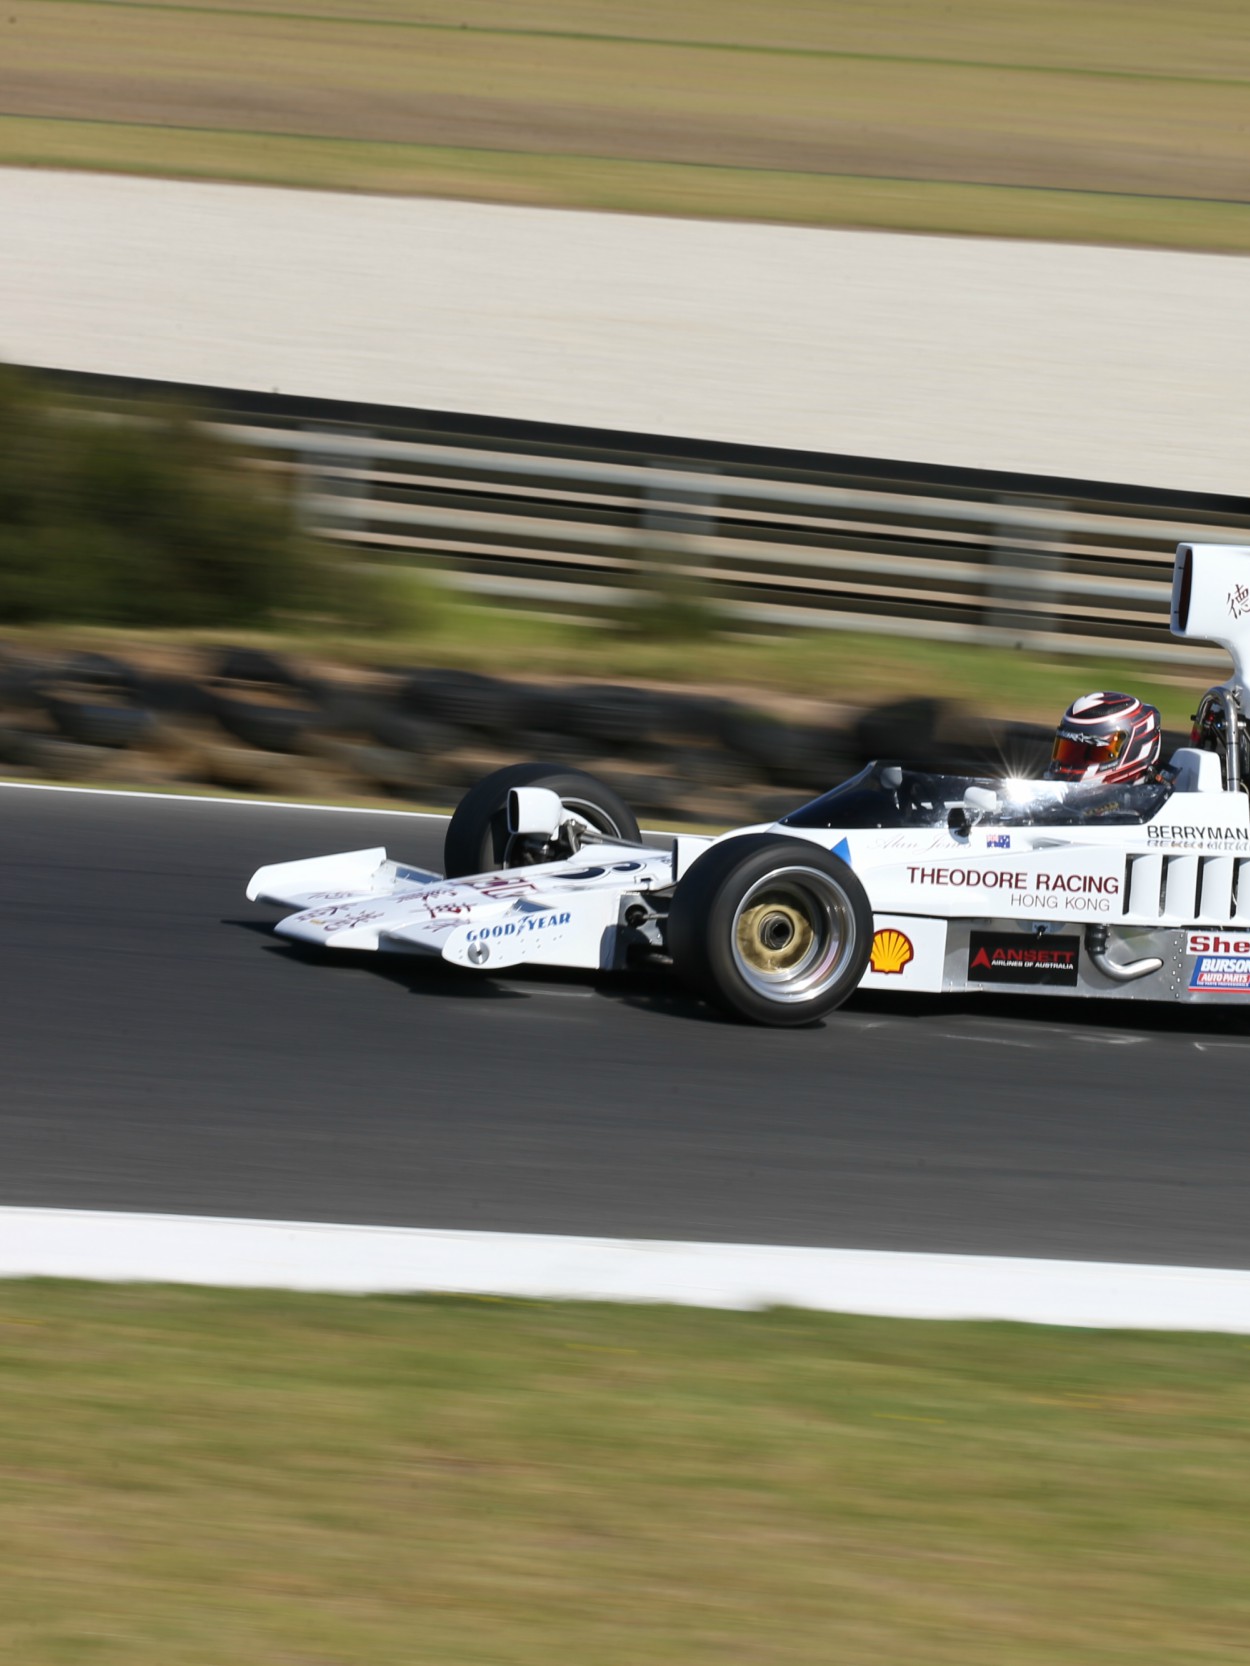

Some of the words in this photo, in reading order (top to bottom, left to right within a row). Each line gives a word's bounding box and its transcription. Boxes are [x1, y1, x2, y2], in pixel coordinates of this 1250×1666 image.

[1147, 825, 1249, 840] BERRYMAN
[906, 866, 1027, 890] THEODORE
[1036, 873, 1119, 895] RACING
[1010, 893, 1058, 909] HONG
[1065, 896, 1110, 912] KONG
[466, 911, 571, 942] GOODYEAR
[992, 948, 1074, 962] ANSETT
[991, 959, 1023, 968] AIRLINES
[1035, 961, 1073, 970] AUSTRALIA
[1201, 973, 1223, 982] AUTO
[1222, 973, 1248, 983] PARTS
